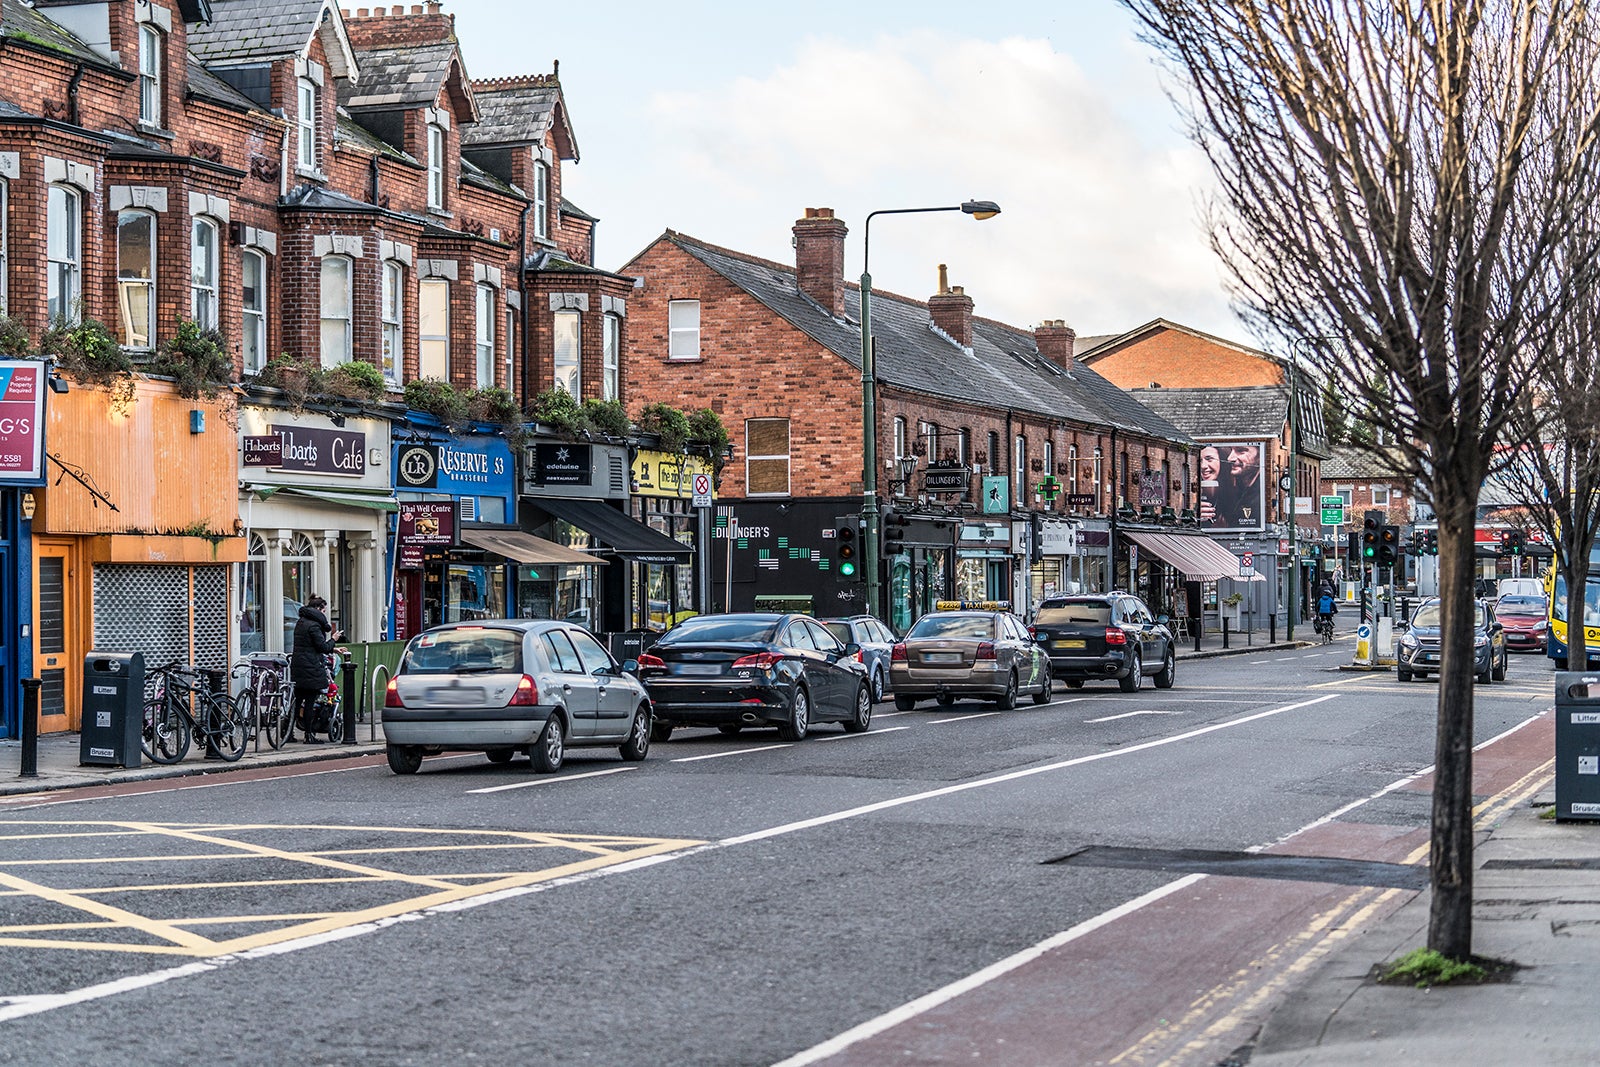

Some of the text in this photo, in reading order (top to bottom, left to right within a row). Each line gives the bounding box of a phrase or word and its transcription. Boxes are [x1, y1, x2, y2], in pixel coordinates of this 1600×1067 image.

[332, 437, 363, 470] Café
[438, 446, 504, 475] RÉSERVE 53
[407, 461, 426, 475] LR
[451, 473, 488, 483] BRASSERIE
[926, 476, 962, 485] DILLINGER'S
[402, 504, 452, 513] Thai Well Centre
[716, 526, 770, 538] DILNGER'S
[964, 601, 983, 609] TAXI
